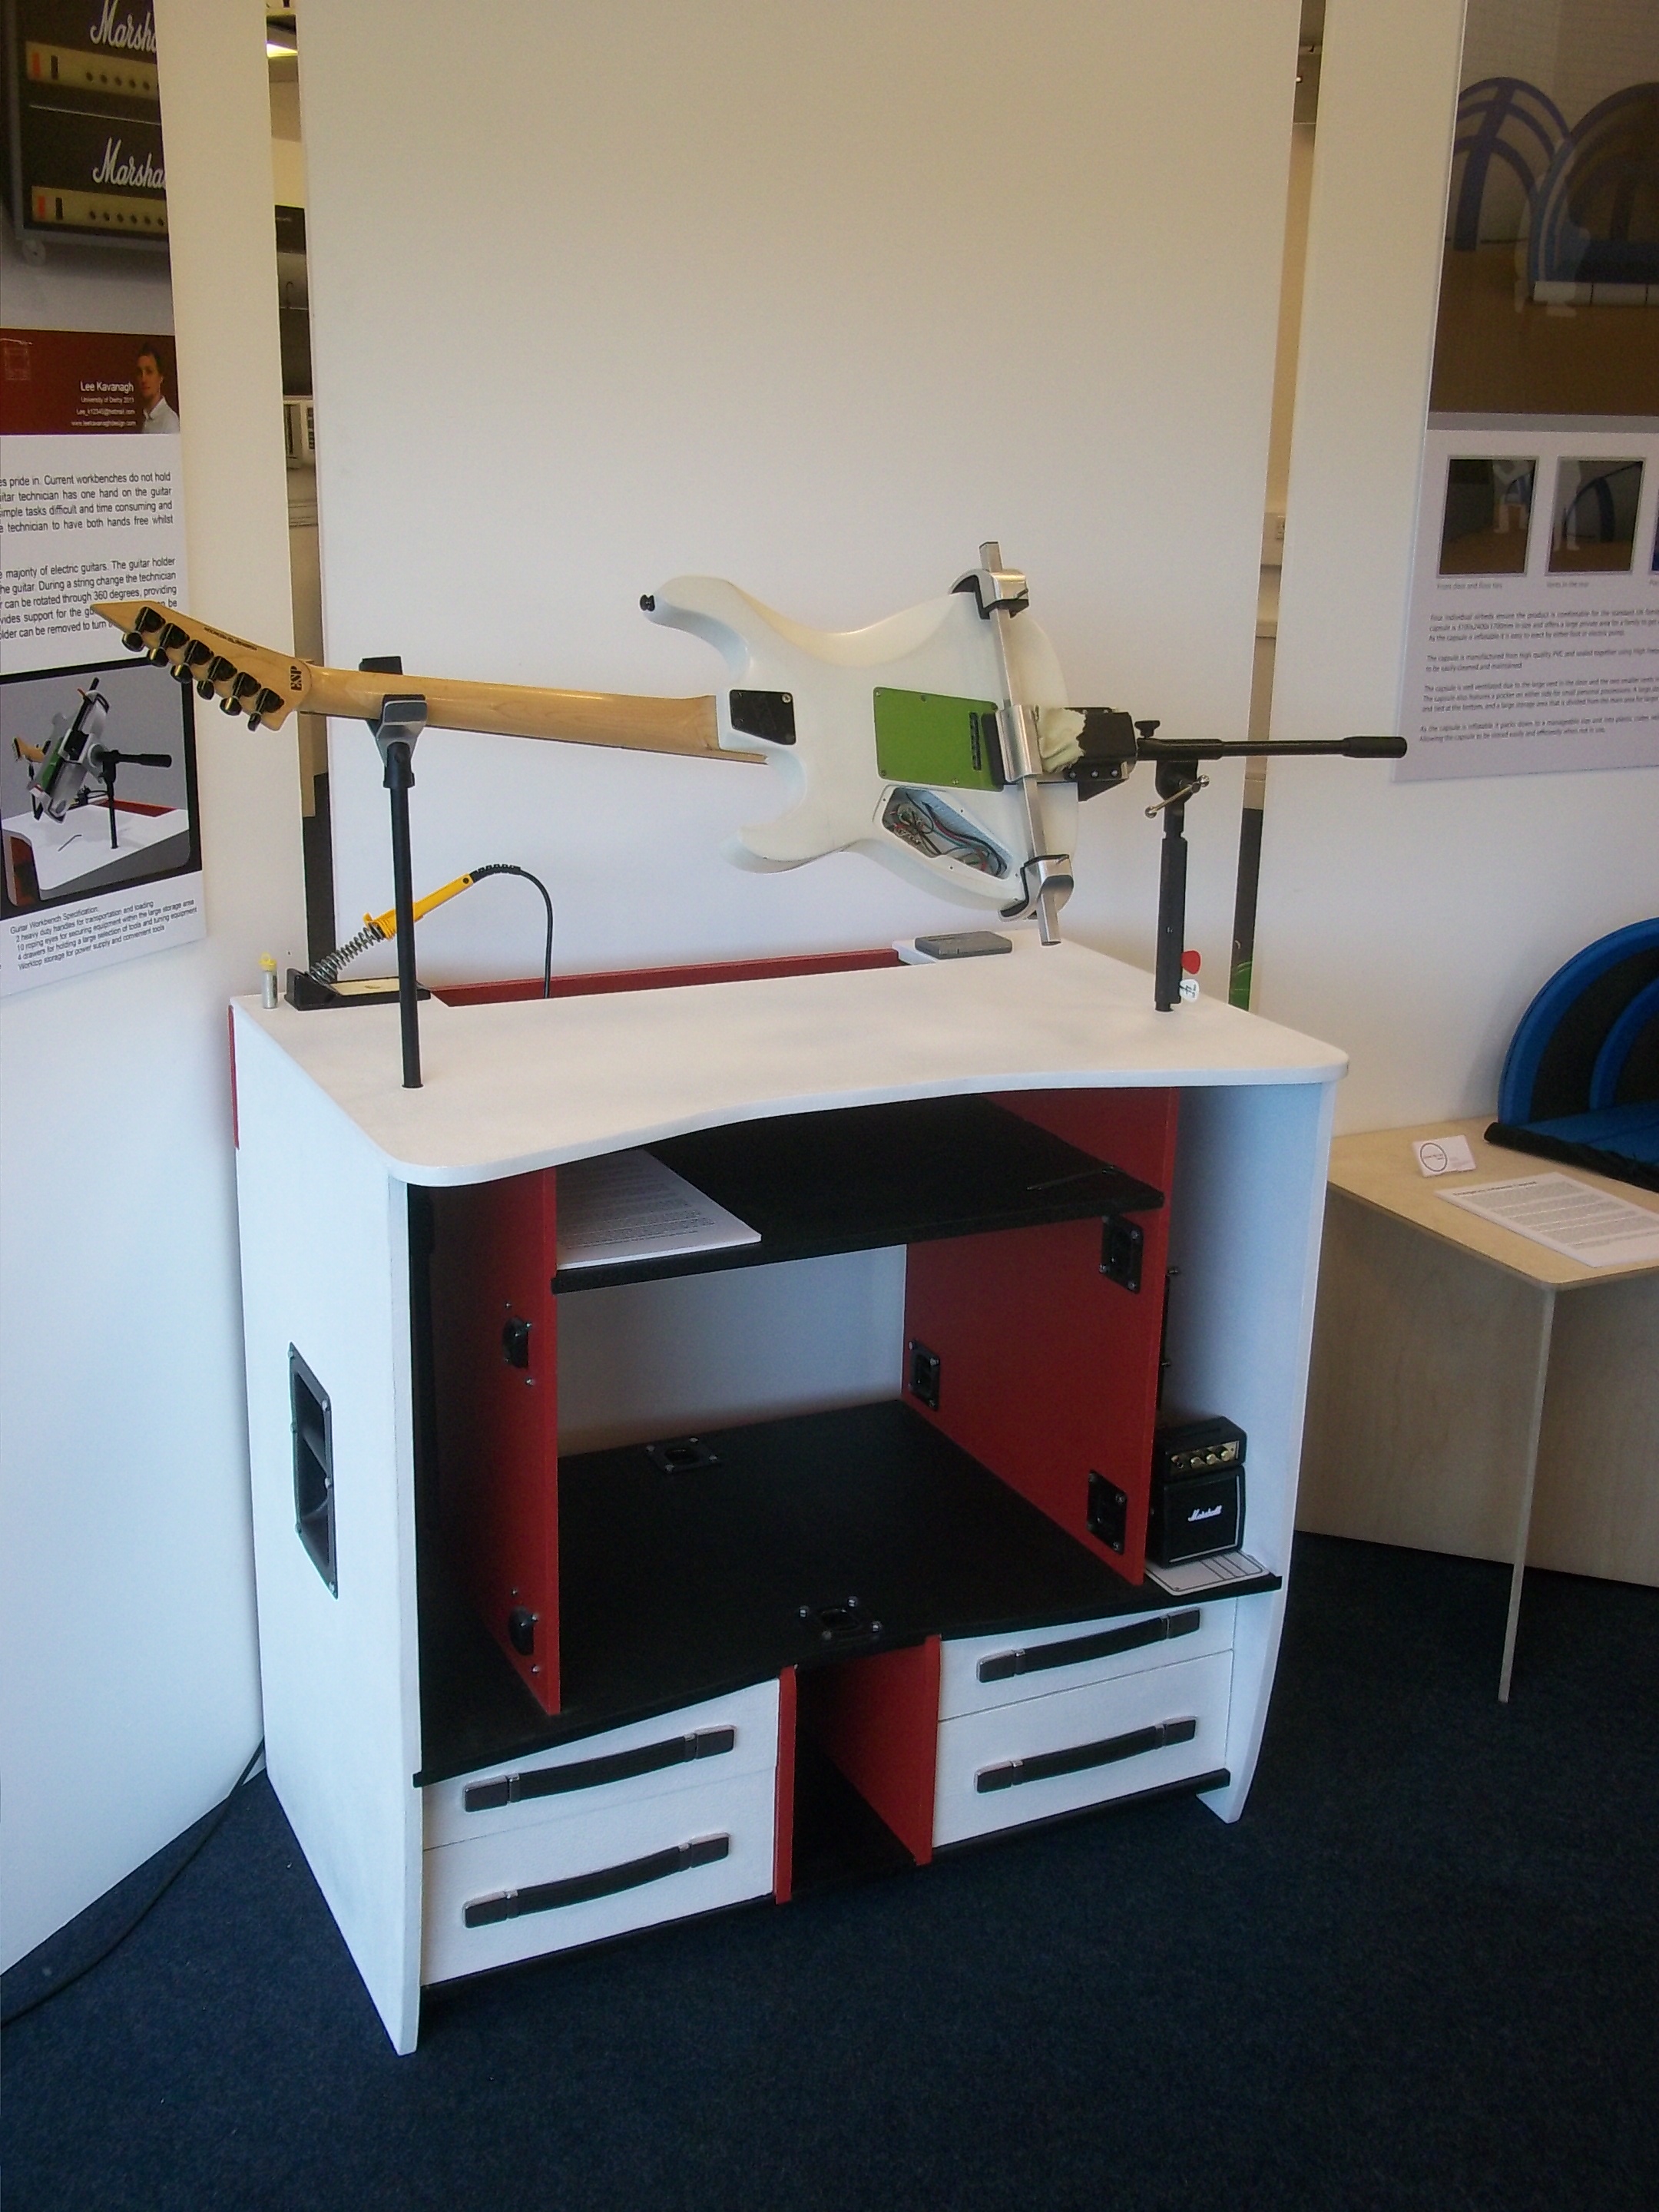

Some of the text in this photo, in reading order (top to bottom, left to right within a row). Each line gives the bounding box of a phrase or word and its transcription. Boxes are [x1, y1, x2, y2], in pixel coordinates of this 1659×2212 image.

[80, 380, 134, 394] Lee Kavanagh
[9, 475, 30, 488] pride
[44, 475, 75, 485] Current
[76, 473, 127, 484] workbenches
[129, 472, 139, 482] do
[141, 473, 153, 482] not
[155, 472, 171, 482] hold
[18, 491, 59, 502] technician
[63, 490, 78, 500] has
[99, 488, 118, 498] hand
[135, 487, 147, 497] the
[151, 487, 171, 498] guitar
[25, 506, 47, 516] tasks
[49, 505, 77, 515] difficult
[79, 504, 94, 514] and
[97, 504, 112, 513] time
[115, 502, 156, 513] consuming
[158, 500, 172, 510] and
[8, 522, 48, 533] technician
[52, 522, 60, 530] to
[63, 519, 83, 529] have
[87, 518, 104, 528] both
[107, 516, 131, 527] hands
[134, 515, 149, 525] free
[152, 514, 174, 525] whilst
[5, 568, 37, 580] majority
[40, 565, 48, 576] of
[51, 565, 79, 575] electric
[81, 563, 109, 575] guitars.
[112, 560, 126, 570] The
[129, 559, 151, 571] guitar
[152, 556, 175, 567] holder
[38, 581, 65, 591] During
[73, 578, 94, 589] string
[96, 575, 124, 587] change
[125, 573, 137, 583] the
[139, 571, 176, 582] technician
[5, 601, 19, 609] can
[22, 598, 31, 608] be
[33, 594, 61, 606] rotated
[62, 591, 92, 603] through
[94, 588, 108, 600] 360
[109, 588, 142, 600] degrees,
[144, 582, 177, 597] providing
[23, 611, 54, 624] support
[56, 609, 67, 619] for
[69, 607, 81, 618] the
[168, 598, 177, 608] be
[18, 629, 34, 637] can
[35, 626, 45, 636] be
[48, 621, 81, 634] removed
[83, 621, 90, 631] to
[92, 621, 107, 629] turn
[290, 665, 303, 691] ESP
[10, 924, 28, 934] Guitar
[29, 913, 61, 929] Workbench
